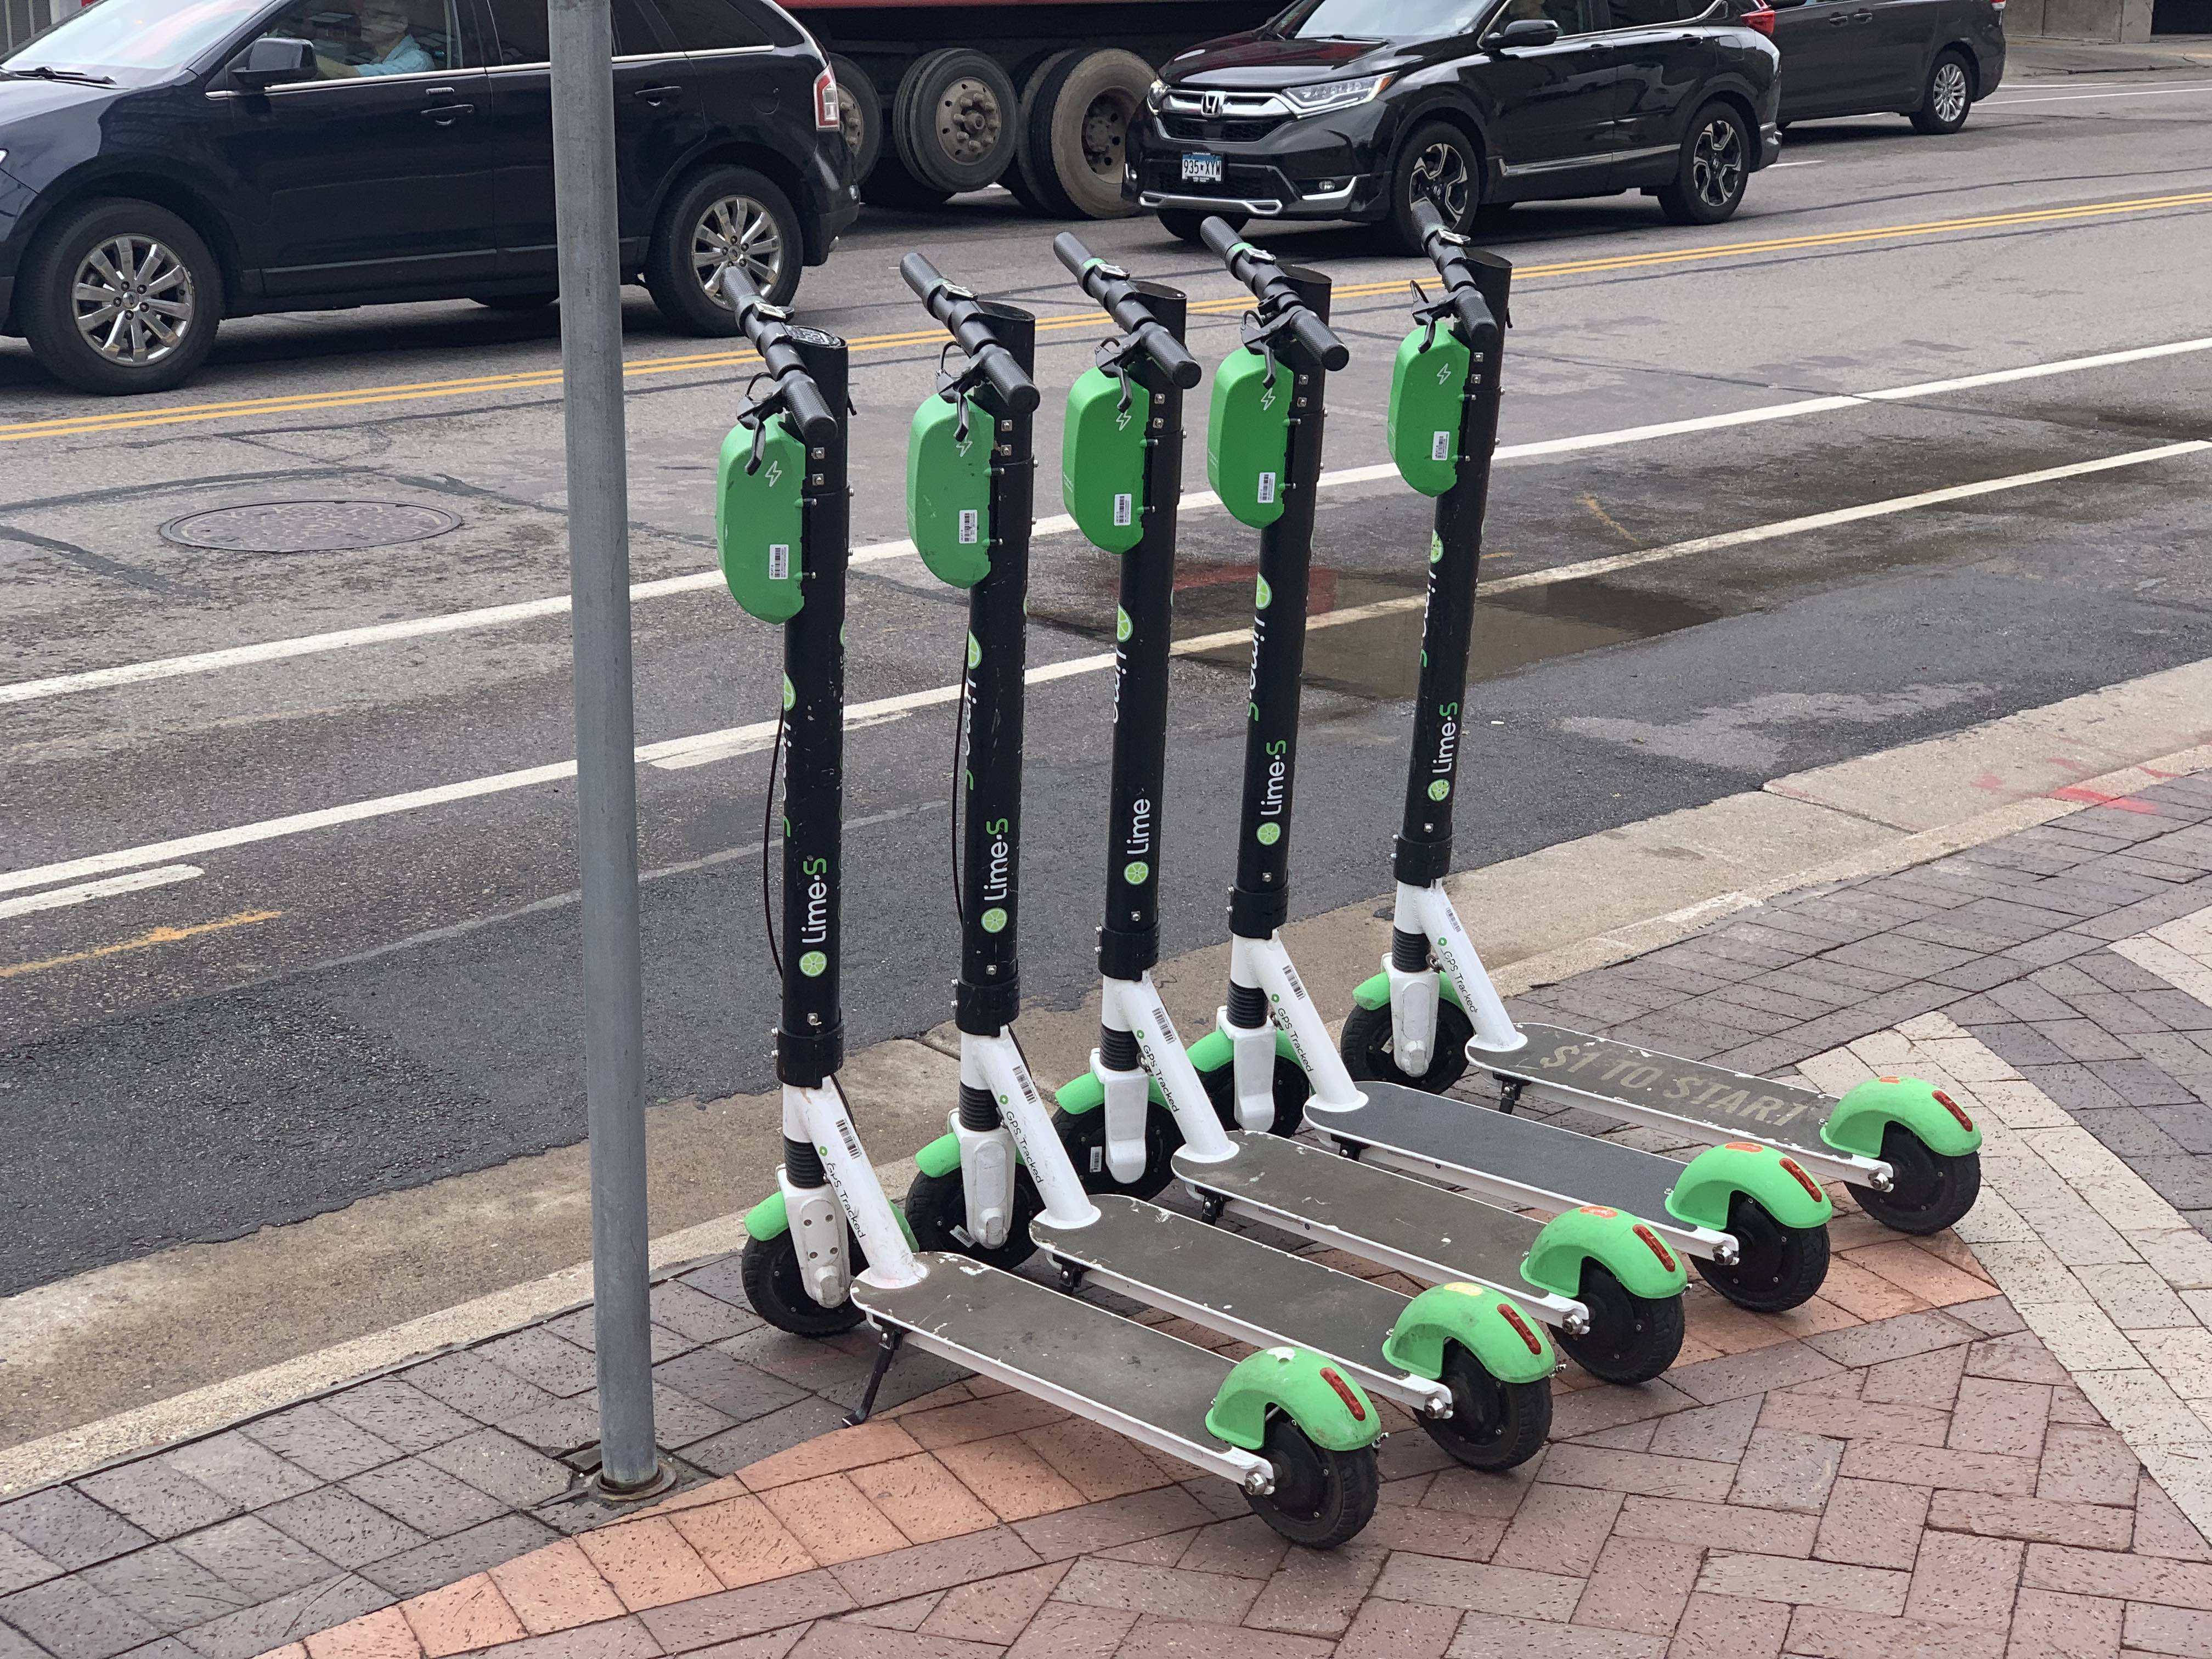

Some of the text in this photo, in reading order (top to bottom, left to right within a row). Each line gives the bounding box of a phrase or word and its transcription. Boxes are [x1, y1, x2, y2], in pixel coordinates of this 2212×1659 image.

[1183, 160, 1199, 174] 935
[1126, 797, 1151, 855] Lime
[1443, 951, 1458, 972] GPS
[1278, 1008, 1314, 1072] GPS Tracked
[1143, 1045, 1180, 1113] GPS Tracked
[1599, 1059, 1664, 1088] TO
[1663, 1076, 1809, 1127] START
[1006, 1111, 1044, 1183] GPS Tracked
[840, 1189, 866, 1238] Tracked
